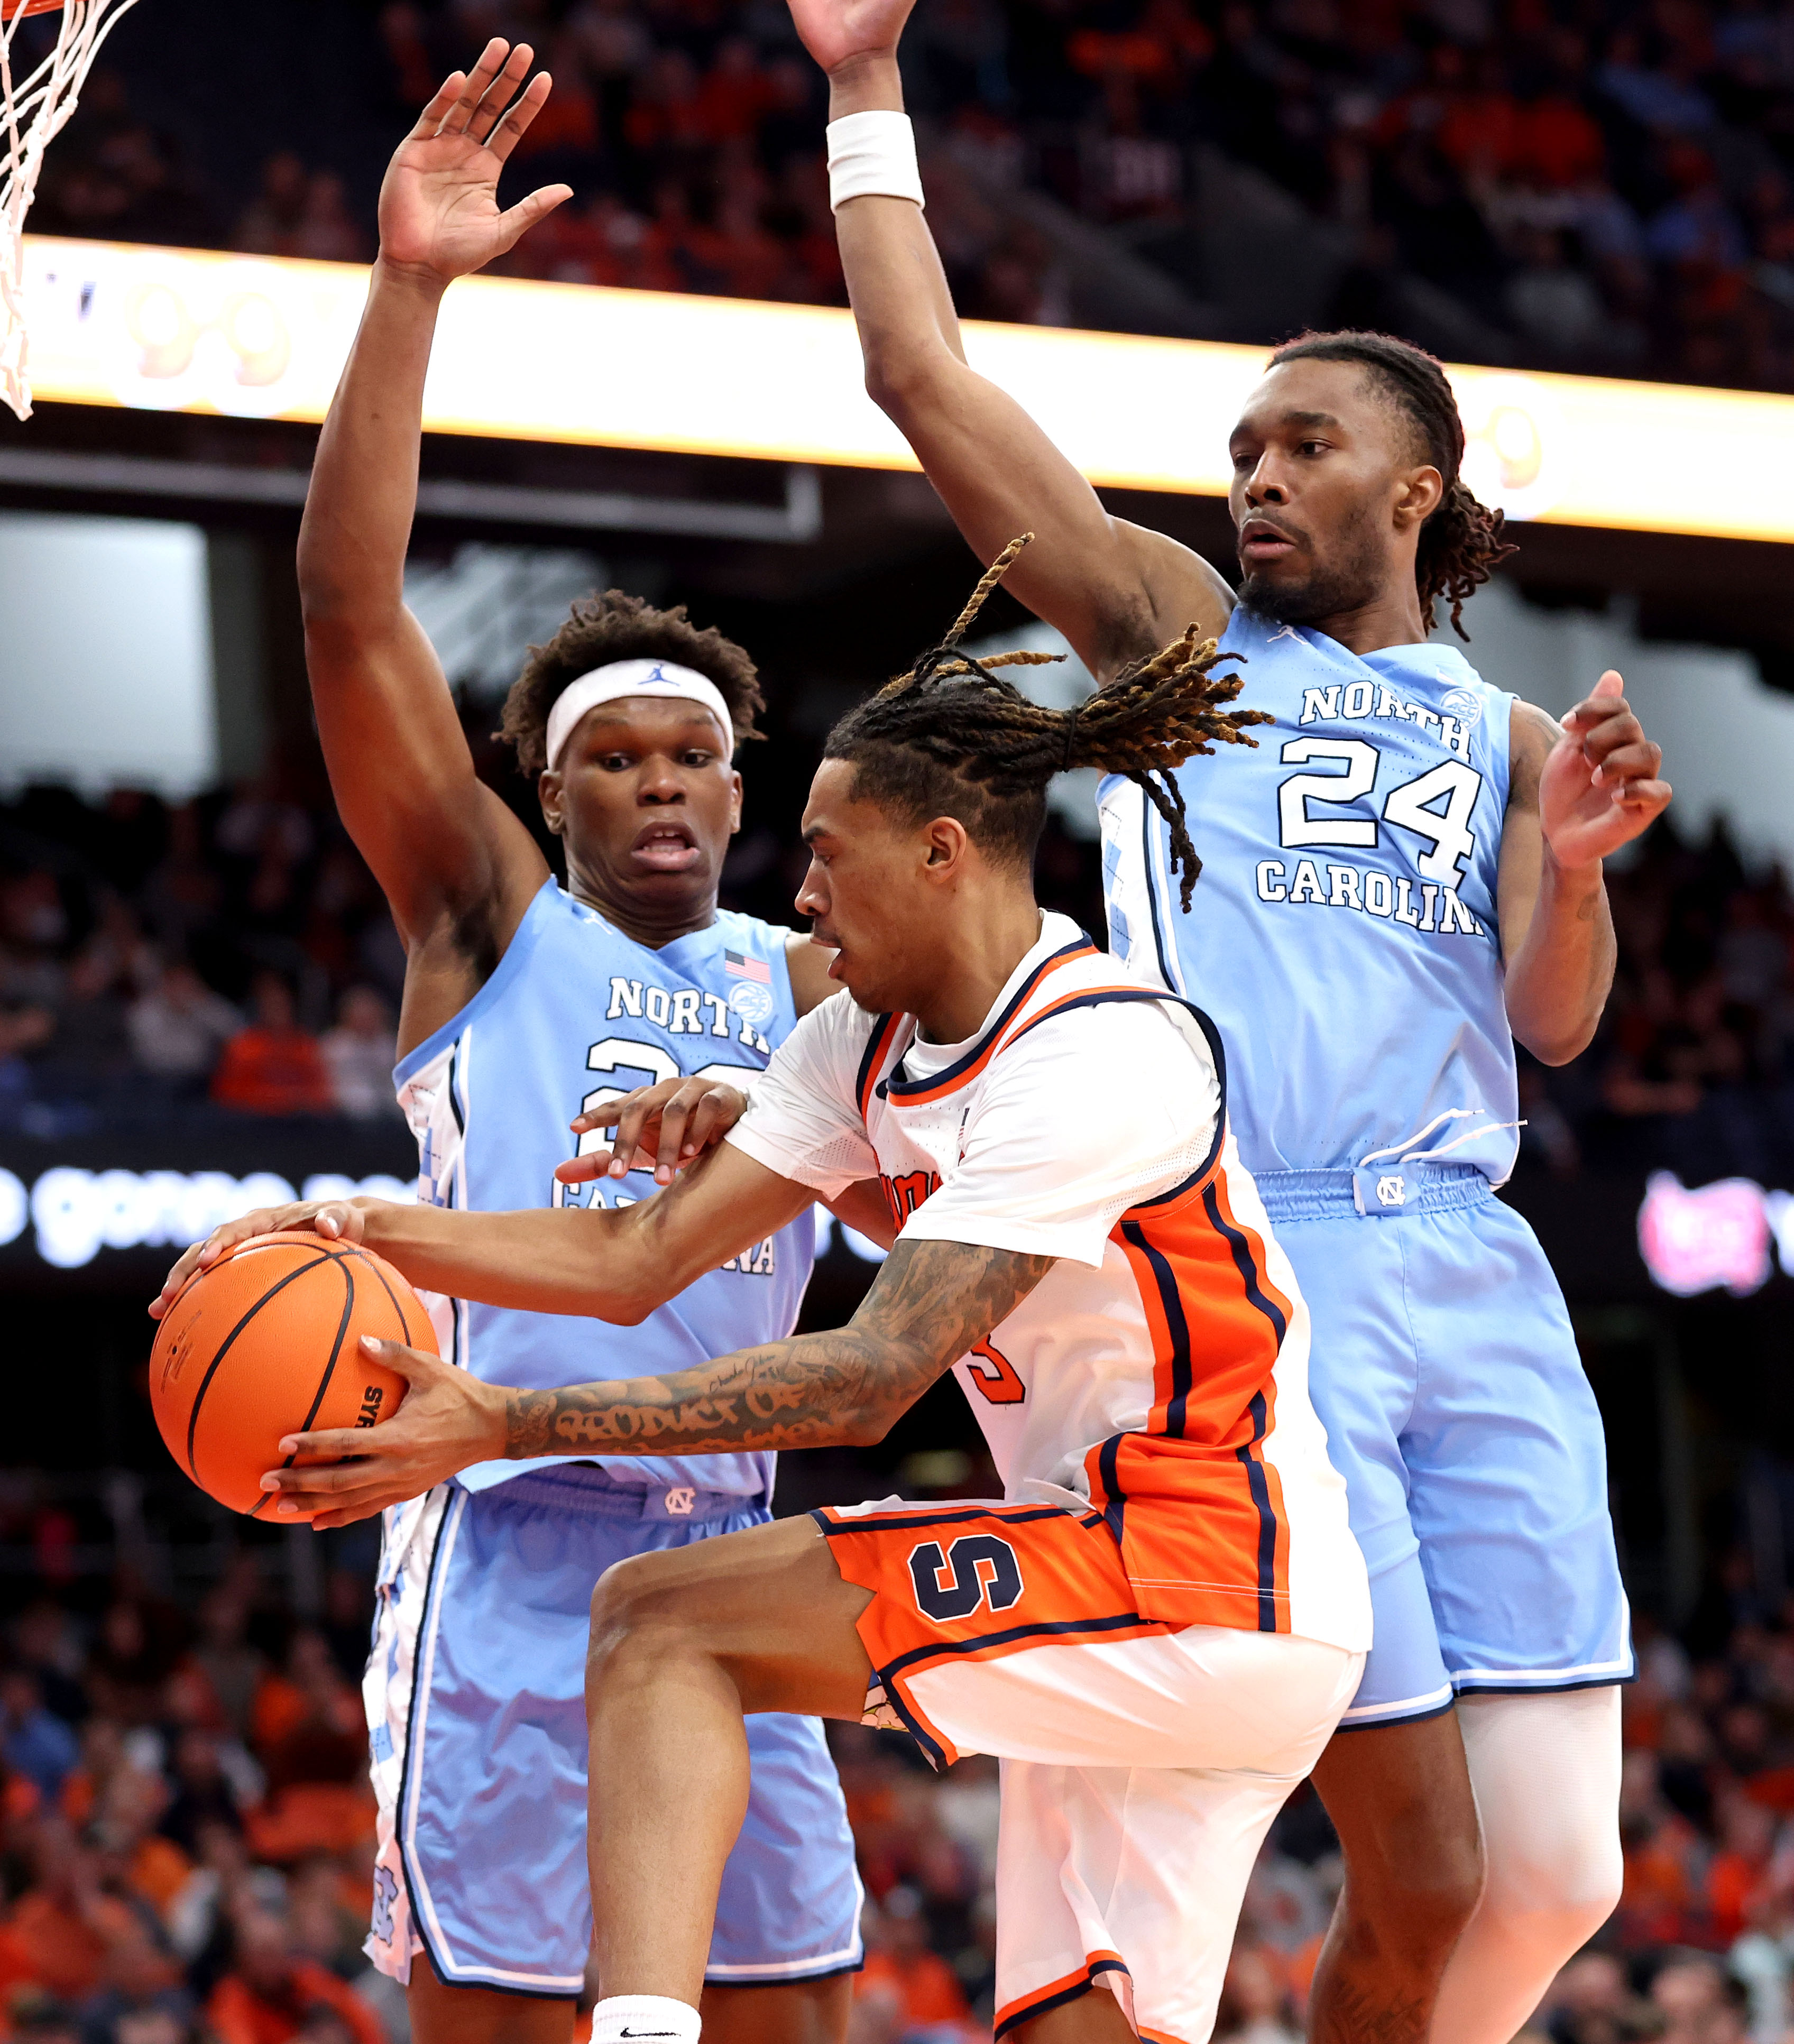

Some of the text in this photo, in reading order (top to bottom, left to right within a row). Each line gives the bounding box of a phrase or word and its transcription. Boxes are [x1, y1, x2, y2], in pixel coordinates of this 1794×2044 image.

[1299, 680, 1471, 764] NORTH
[1277, 736, 1483, 892] 24
[1255, 860, 1485, 936] CAROLIN
[908, 1533, 1025, 1623] S
